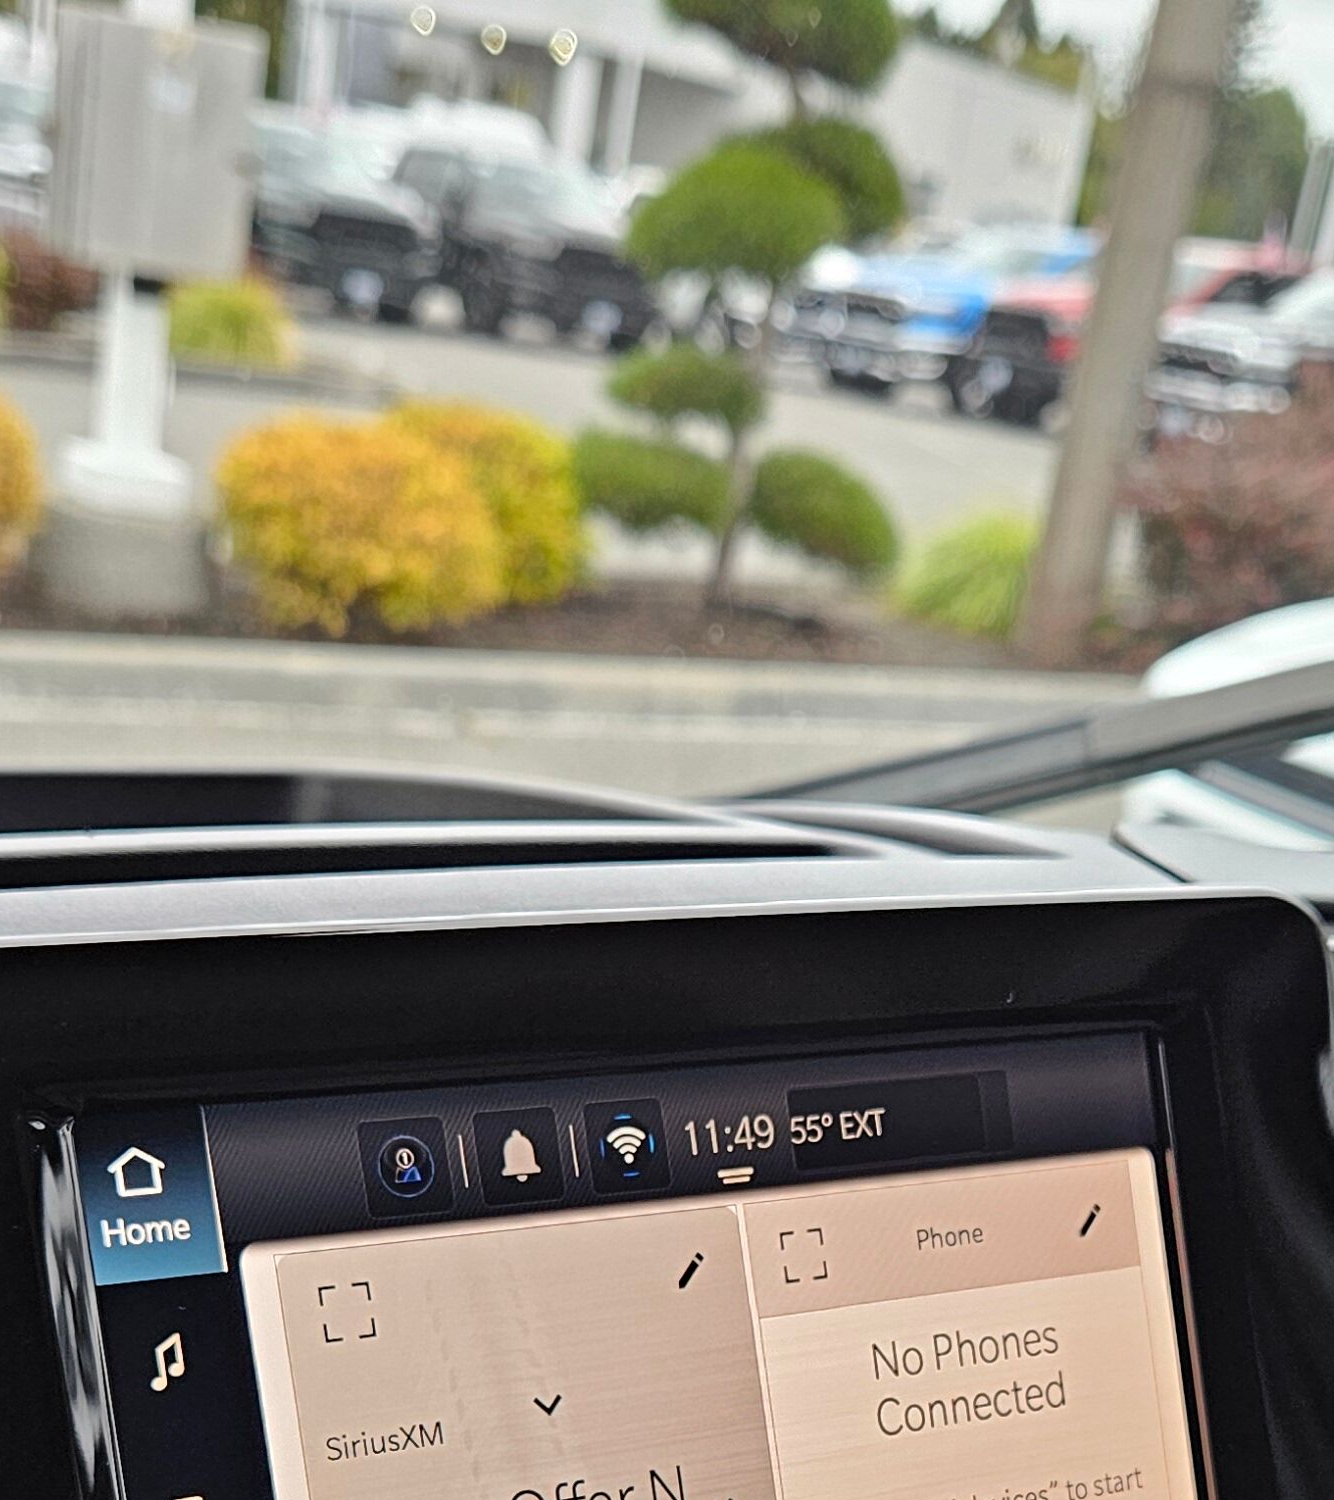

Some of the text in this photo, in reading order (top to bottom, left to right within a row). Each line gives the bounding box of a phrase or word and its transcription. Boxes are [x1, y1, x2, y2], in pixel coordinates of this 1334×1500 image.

[684, 1113, 775, 1156] 11:49
[839, 1107, 886, 1141] EXT
[100, 1214, 191, 1249] Home
[915, 1224, 984, 1251] Phone
[871, 1325, 1059, 1380] No Phones
[876, 1370, 1067, 1436] Connected
[325, 1421, 444, 1462] SiriusXM
[1093, 1466, 1144, 1498] start
